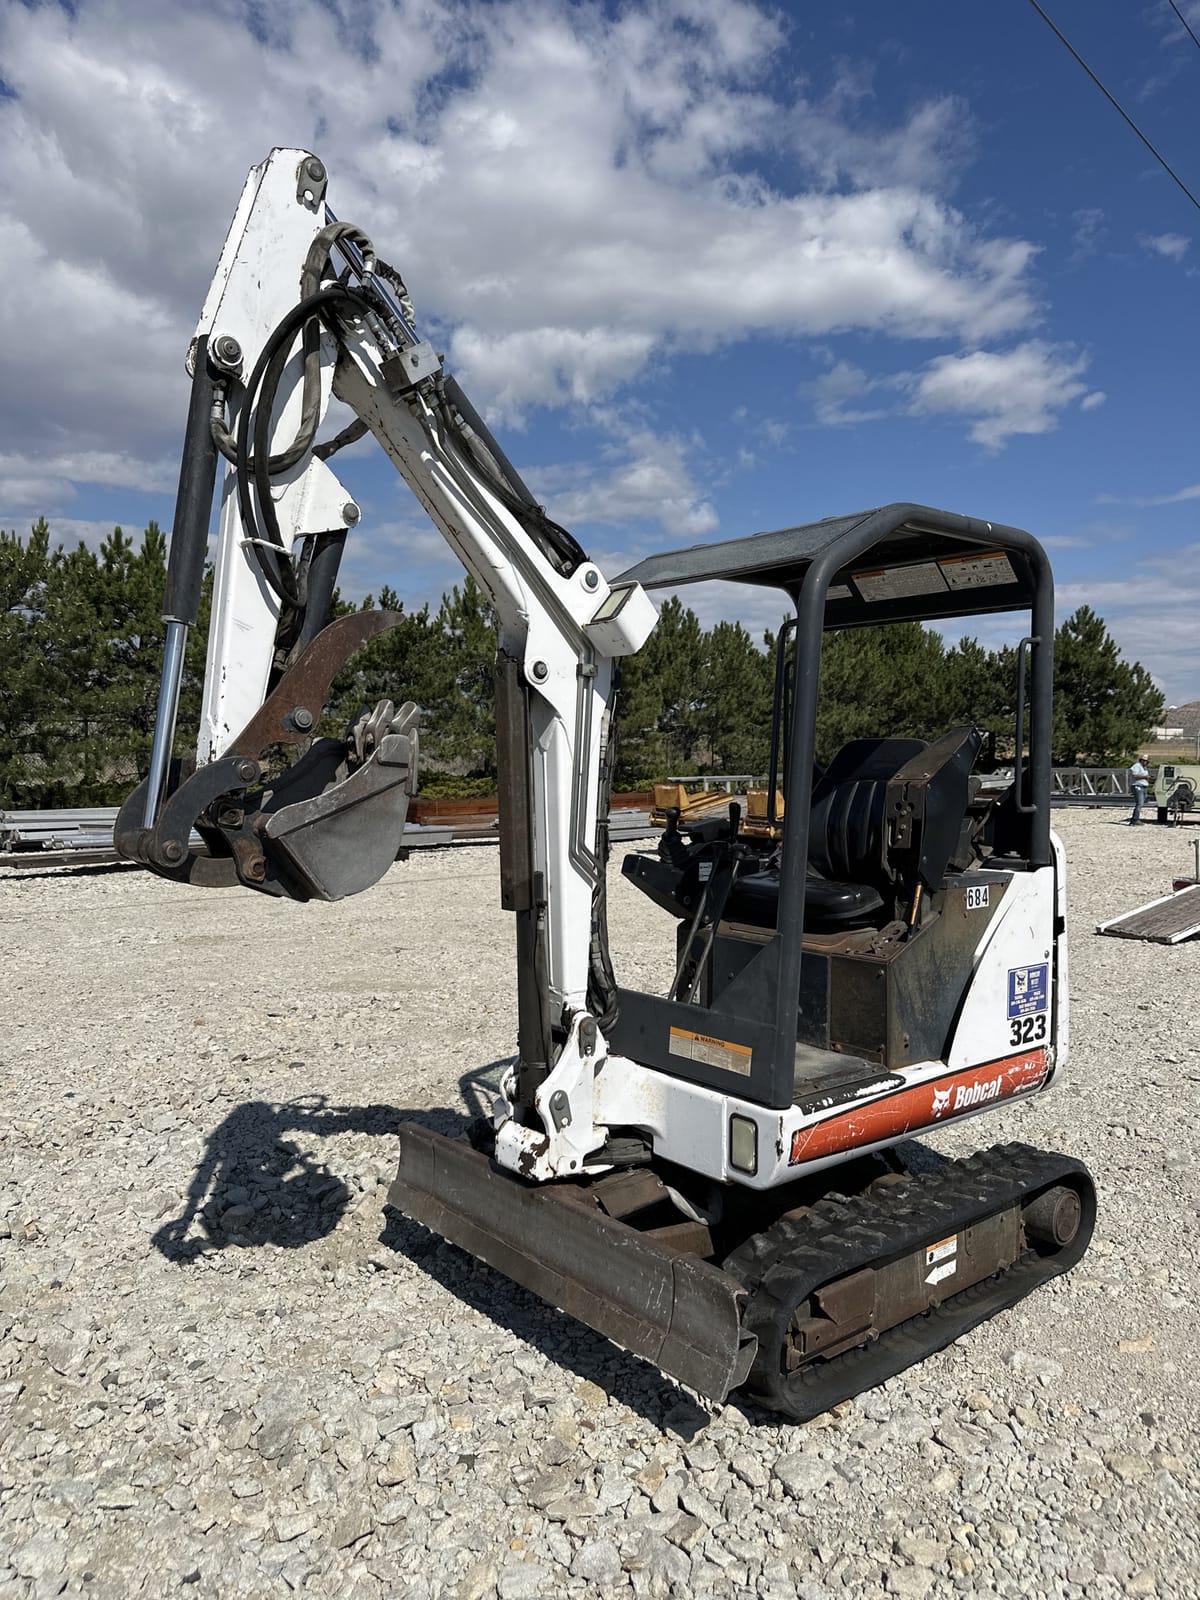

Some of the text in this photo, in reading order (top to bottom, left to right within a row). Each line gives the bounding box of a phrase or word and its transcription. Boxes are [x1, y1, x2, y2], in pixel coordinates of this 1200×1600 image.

[968, 887, 988, 907] 684
[700, 1036, 725, 1047] WARNING
[1010, 1014, 1046, 1047] 323
[953, 1075, 1002, 1110] Bobcat
